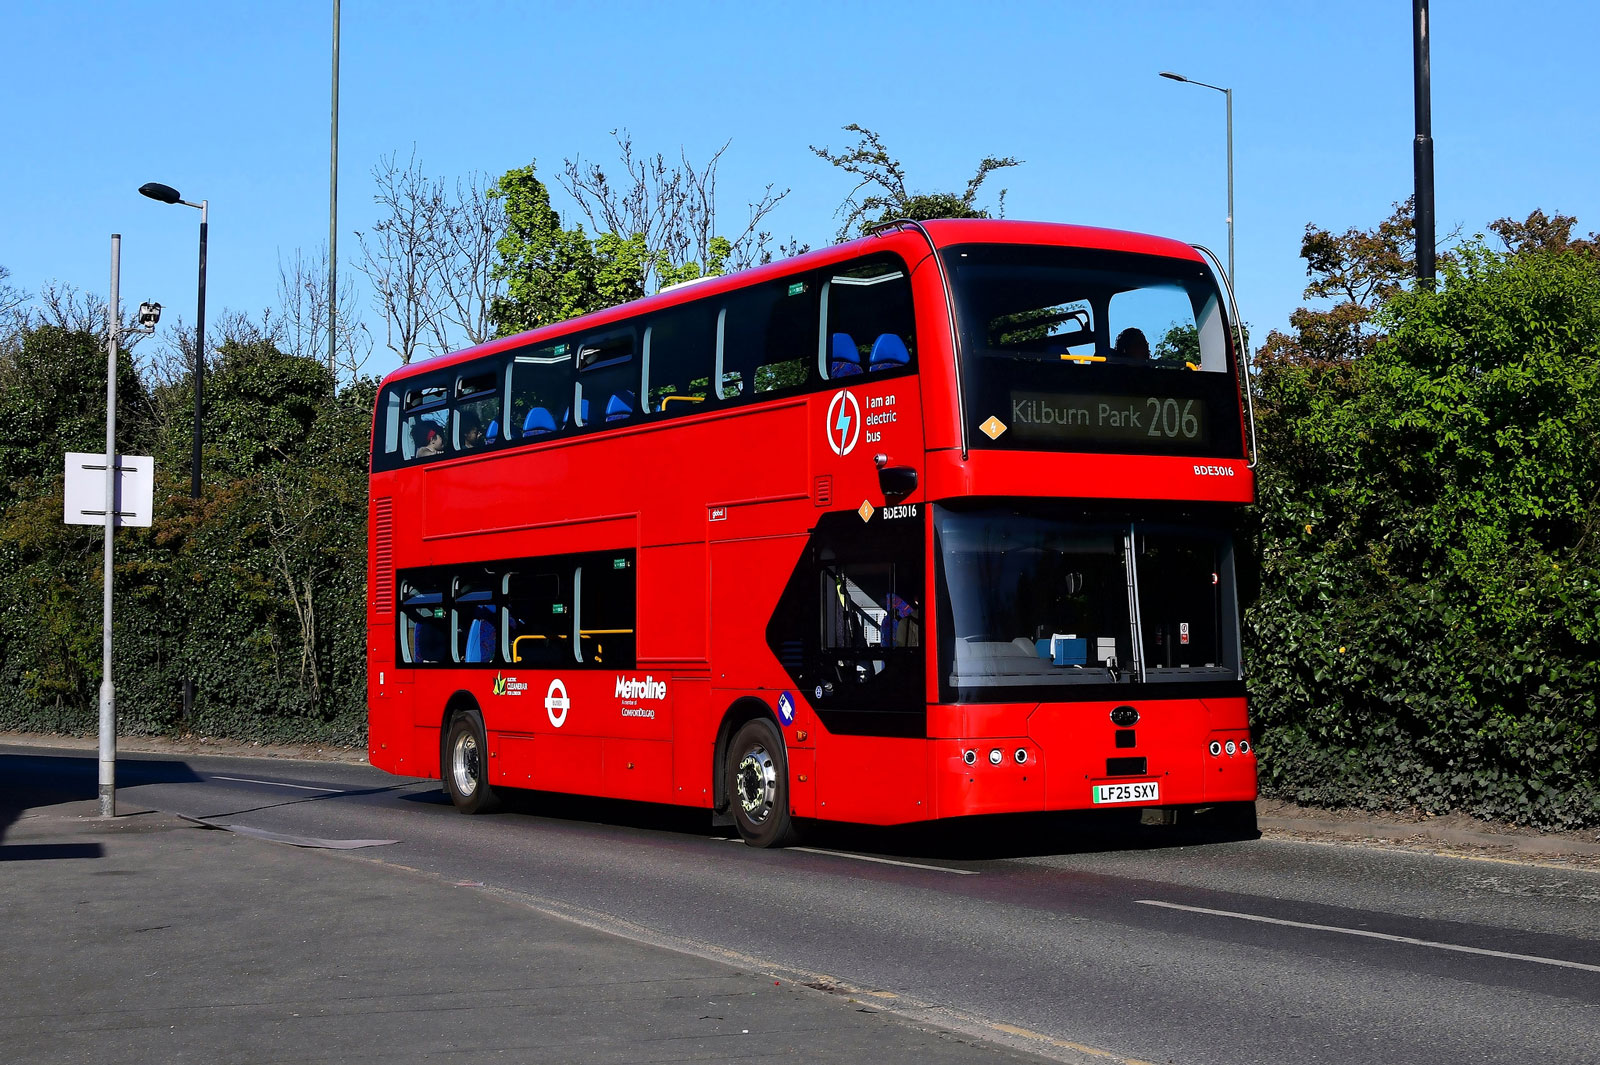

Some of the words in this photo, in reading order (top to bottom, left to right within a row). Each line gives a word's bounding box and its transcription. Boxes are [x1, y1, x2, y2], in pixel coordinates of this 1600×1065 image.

[870, 397, 883, 408] am
[885, 394, 896, 406] an
[866, 411, 897, 425] electric
[1012, 399, 1089, 425] Kilburn
[1098, 403, 1141, 428] Park
[1146, 397, 1198, 438] 206
[866, 430, 881, 443] bus
[1193, 465, 1234, 477] BDE3016
[883, 504, 917, 520] BDE3016
[615, 675, 667, 700] Metroline
[1101, 787, 1131, 800] LF25
[1134, 785, 1156, 798] SXY
